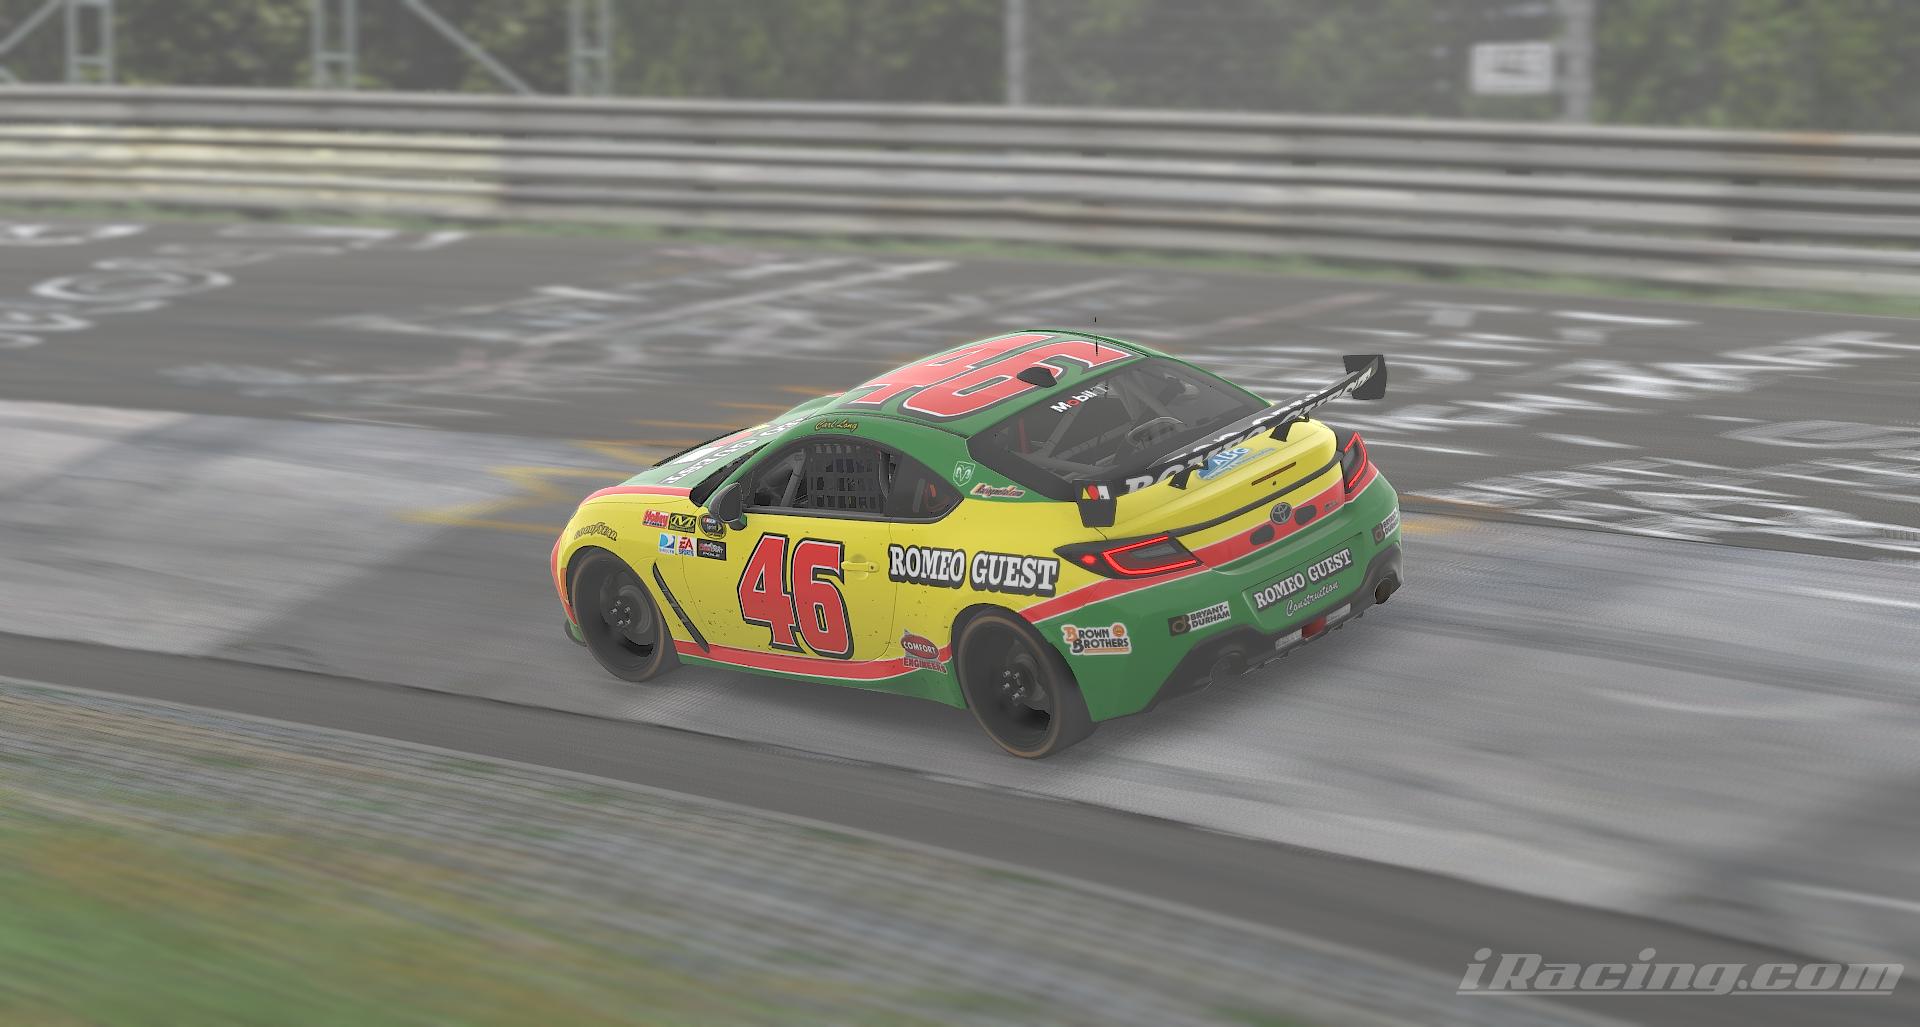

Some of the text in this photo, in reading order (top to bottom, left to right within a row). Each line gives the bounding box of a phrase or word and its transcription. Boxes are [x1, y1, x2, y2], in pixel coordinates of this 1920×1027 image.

[1050, 390, 1098, 413] Mobil
[815, 419, 836, 432] Carl
[837, 419, 859, 432] Long
[679, 537, 693, 550] EA
[889, 545, 1058, 593] ROMEO GUEST
[1254, 548, 1352, 609] ROMEO GUEST
[737, 532, 854, 660] 46
[1286, 582, 1338, 616] Construction
[1191, 604, 1228, 621] BRYANT-
[1192, 610, 1230, 629] DURHAM
[1063, 626, 1110, 643] BROWN
[903, 641, 937, 655] COMFORT
[1072, 638, 1129, 654] BROTHERS
[903, 657, 948, 674] ENGINEERS
